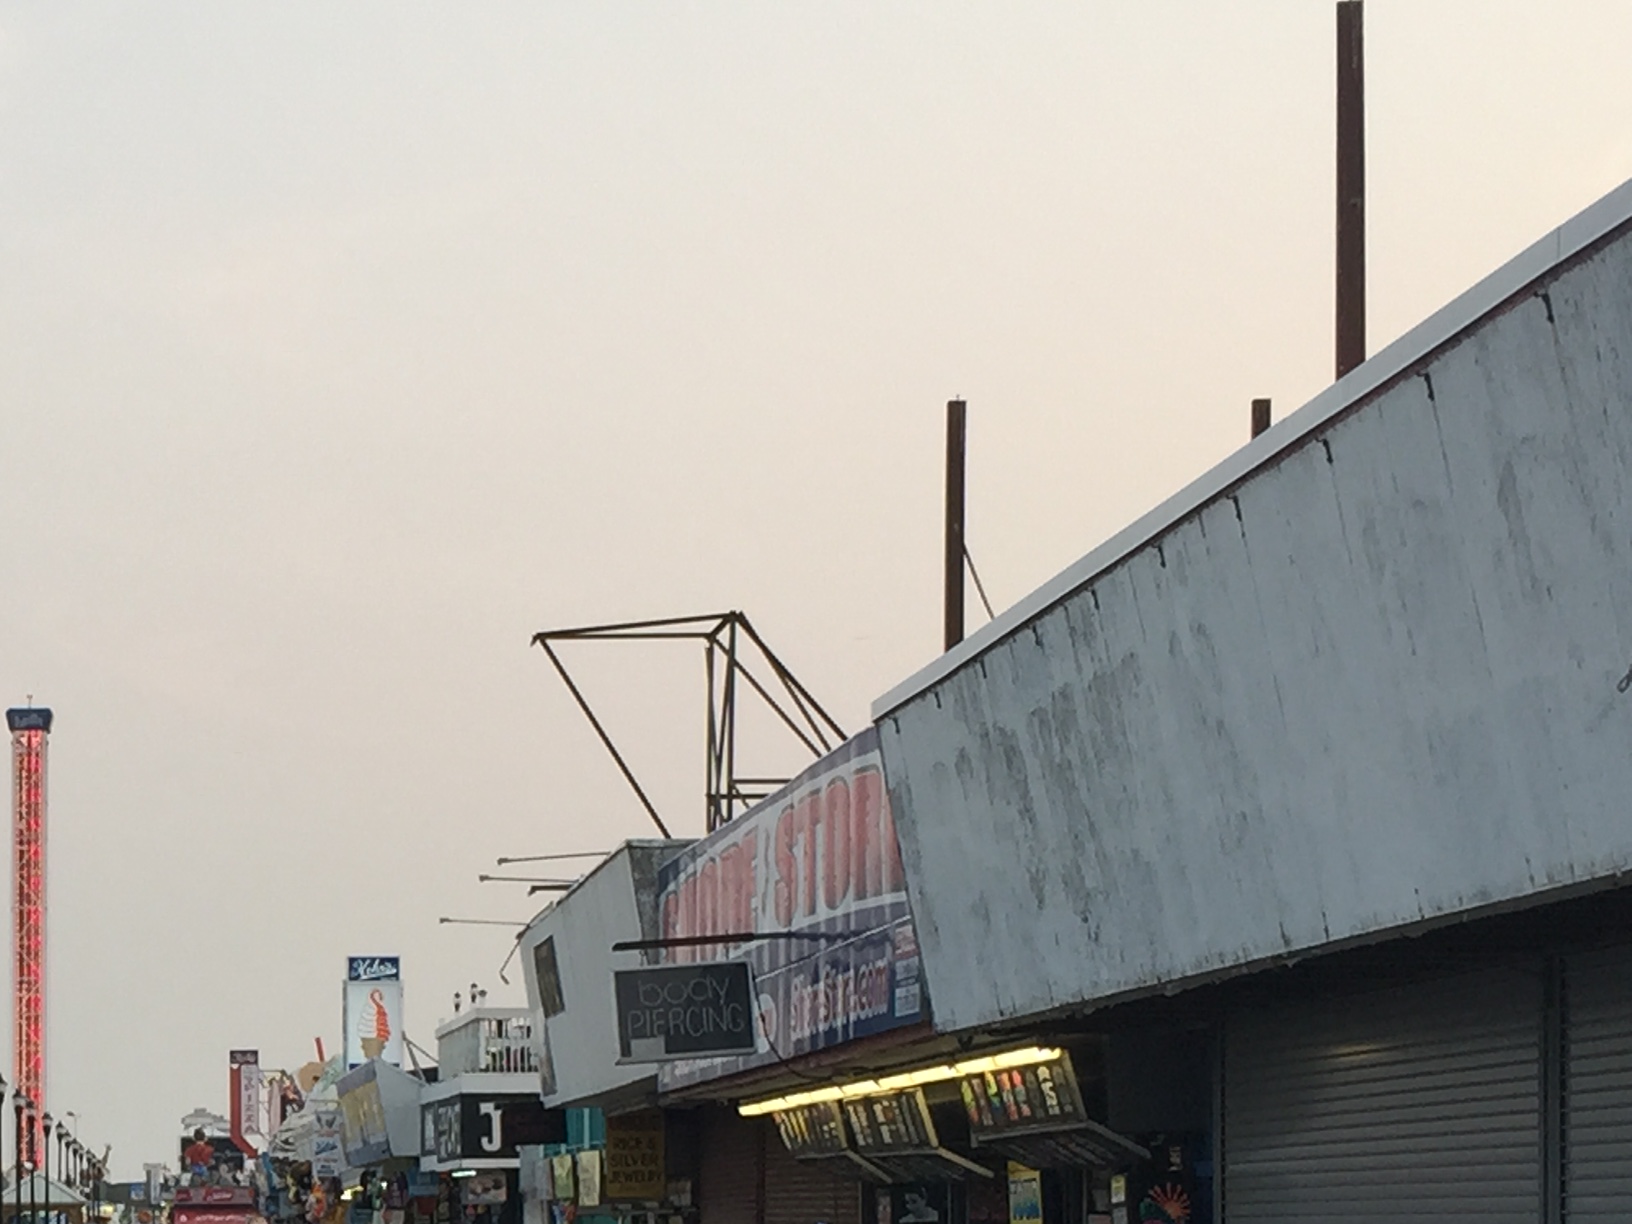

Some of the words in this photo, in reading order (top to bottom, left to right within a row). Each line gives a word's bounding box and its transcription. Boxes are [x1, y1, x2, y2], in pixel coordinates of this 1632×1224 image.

[638, 974, 731, 1004] body
[627, 1002, 746, 1038] PIERCING
[610, 1152, 659, 1168] SILVER
